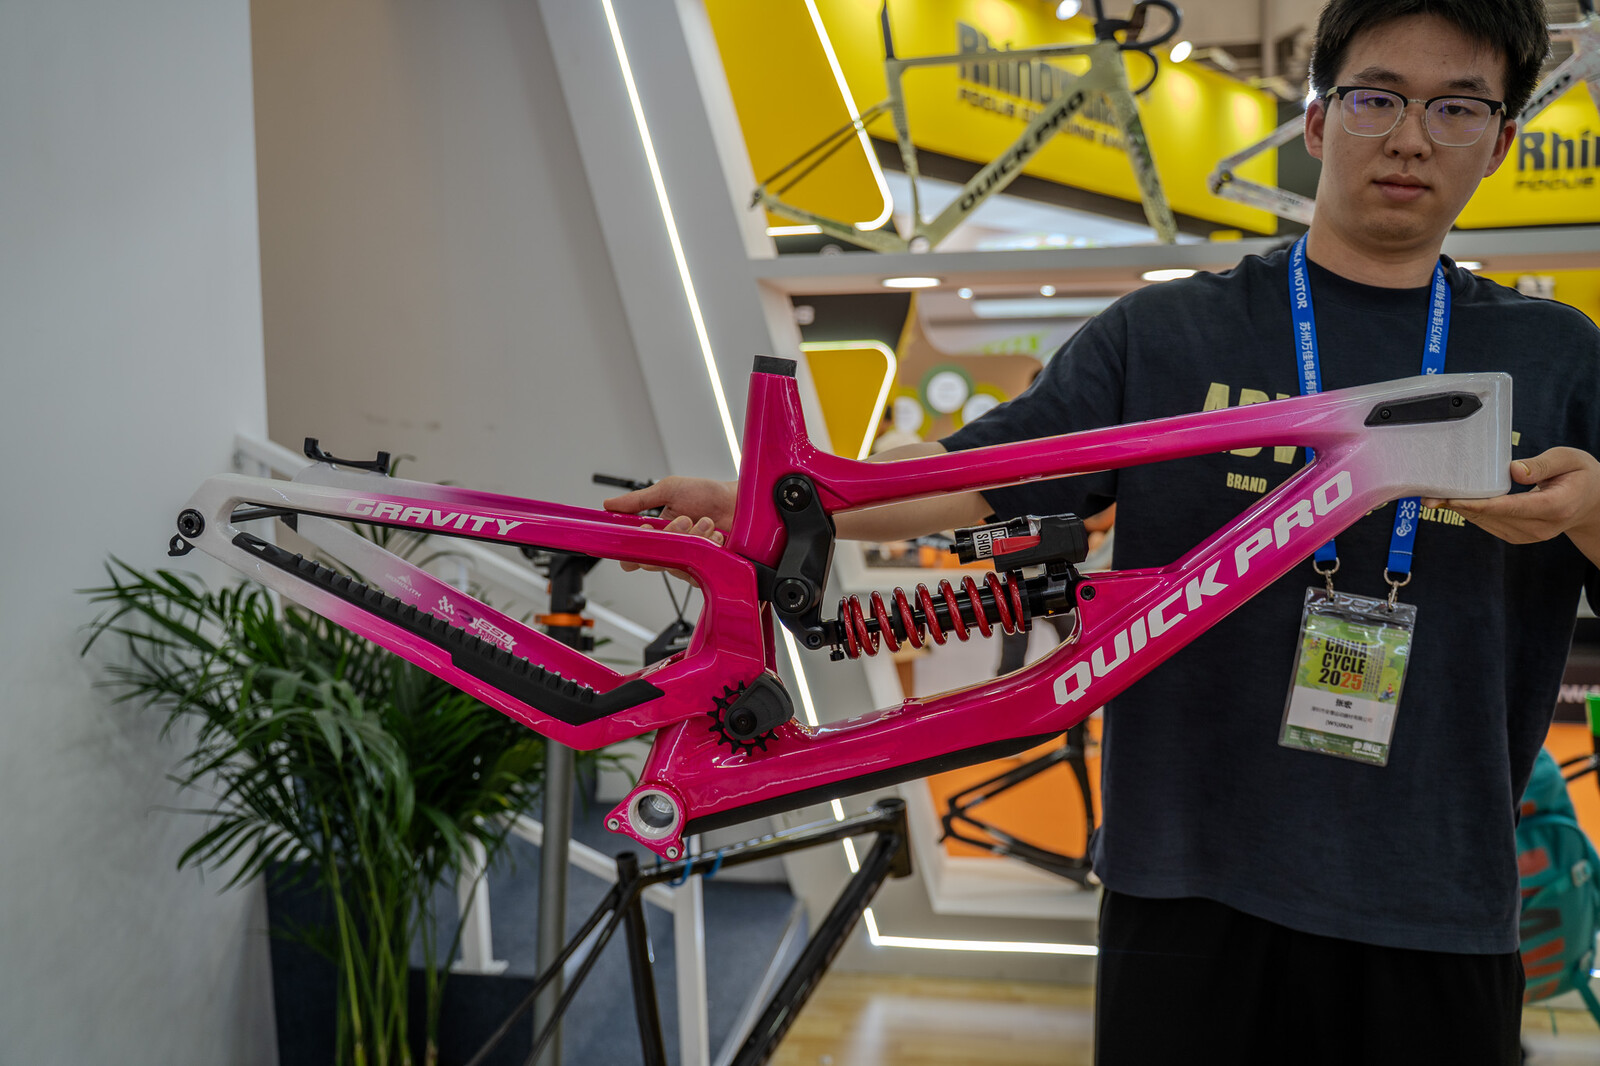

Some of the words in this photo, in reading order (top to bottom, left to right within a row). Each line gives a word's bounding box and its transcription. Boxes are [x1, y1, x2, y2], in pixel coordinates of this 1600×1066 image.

[959, 142, 1030, 212] QUICK
[1034, 91, 1085, 142] PRO
[1294, 267, 1308, 309] MOTOR
[1226, 472, 1267, 493] BRAND
[346, 499, 525, 535] GRAVITY
[976, 533, 993, 556] SHOX
[1053, 559, 1229, 705] QUICK
[1234, 470, 1353, 578] PRO
[1326, 638, 1367, 658] CHINA
[1322, 653, 1366, 674] CYCLE
[1318, 668, 1362, 690] 2025
